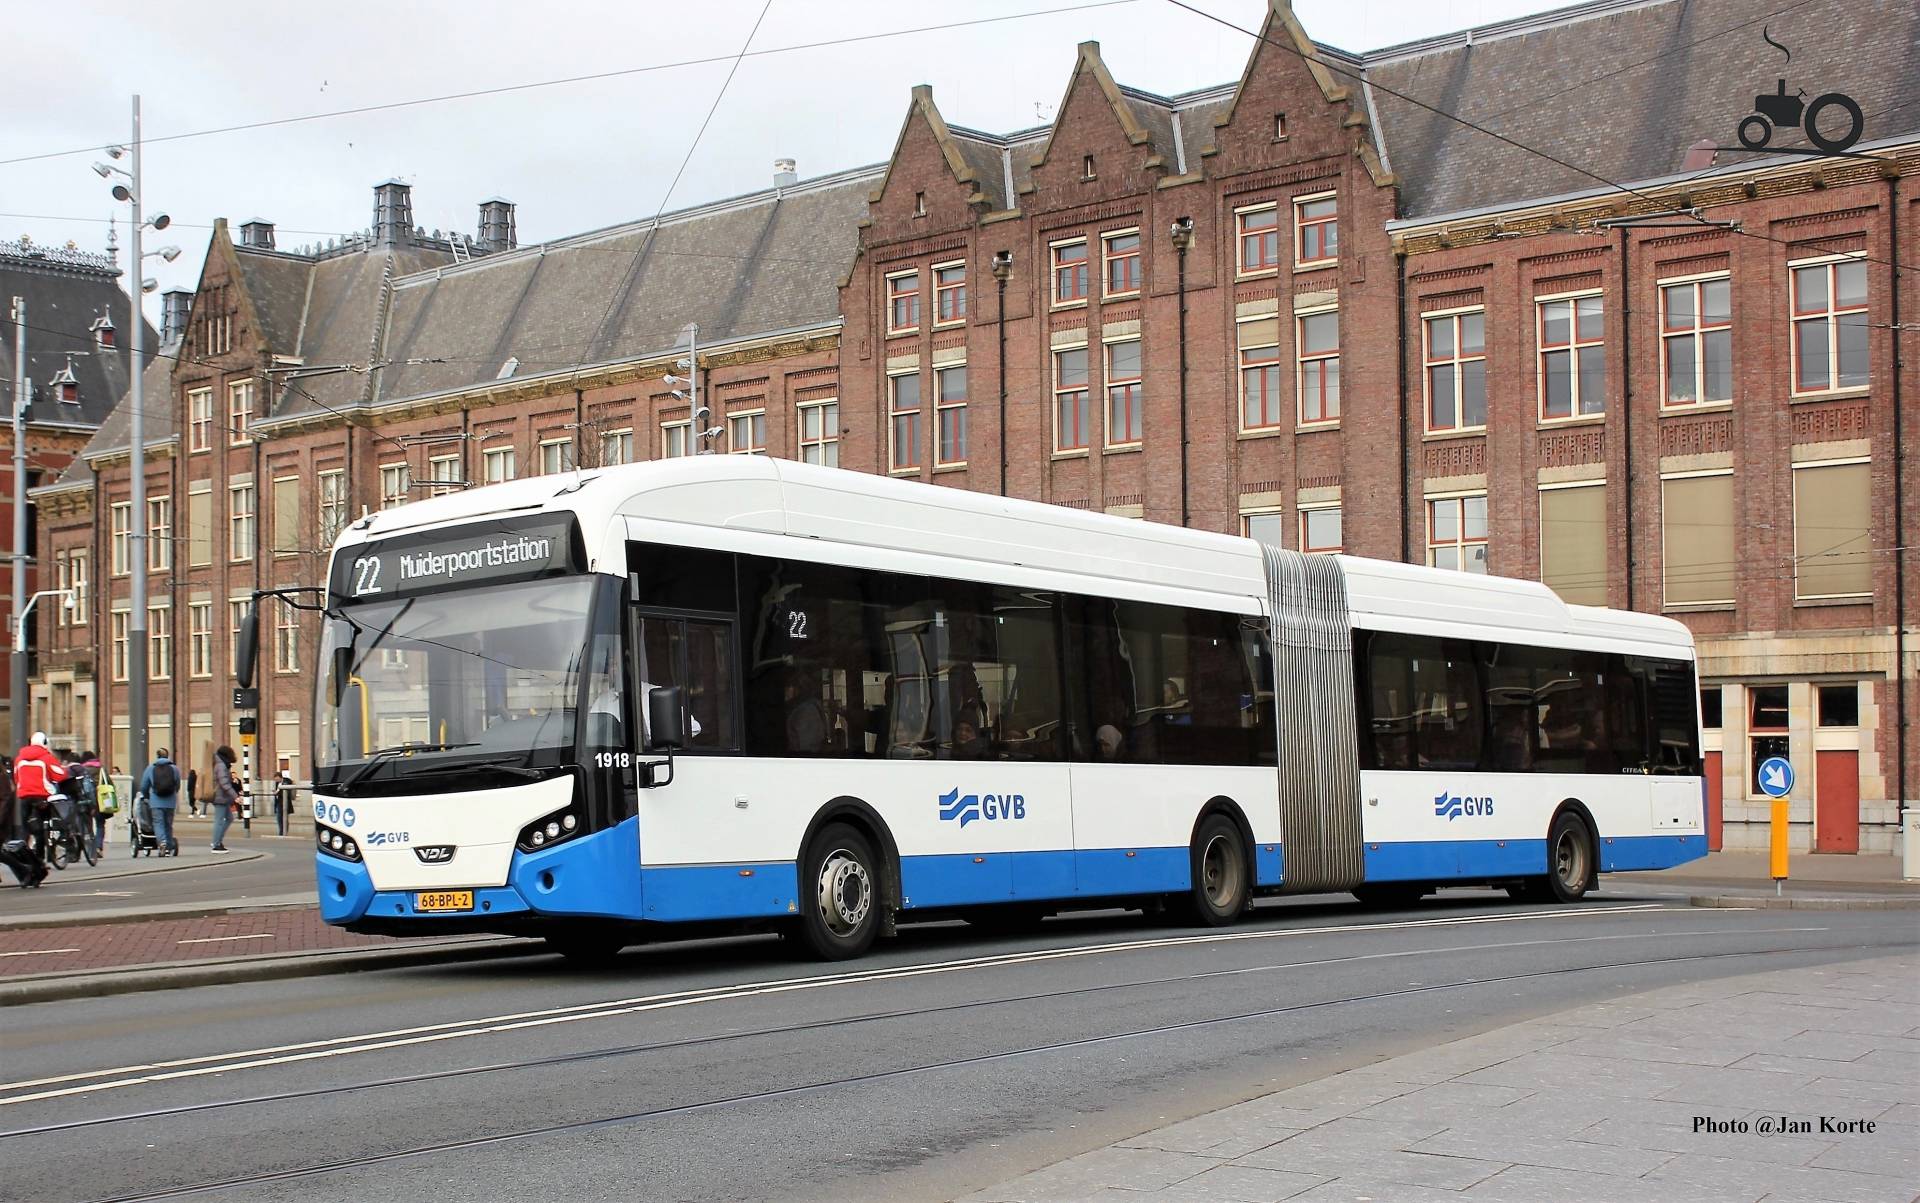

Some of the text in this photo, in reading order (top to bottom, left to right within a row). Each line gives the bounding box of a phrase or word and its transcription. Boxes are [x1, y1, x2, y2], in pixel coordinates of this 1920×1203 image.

[352, 537, 550, 597] 22 Muiderpoortstation
[788, 611, 807, 638] 22
[594, 752, 630, 769] 1918
[982, 794, 1026, 820] GVB
[1464, 796, 1494, 816] GVB
[387, 832, 410, 843] GVB
[418, 847, 450, 860] VDL
[421, 893, 469, 908] 68-BPL-2
